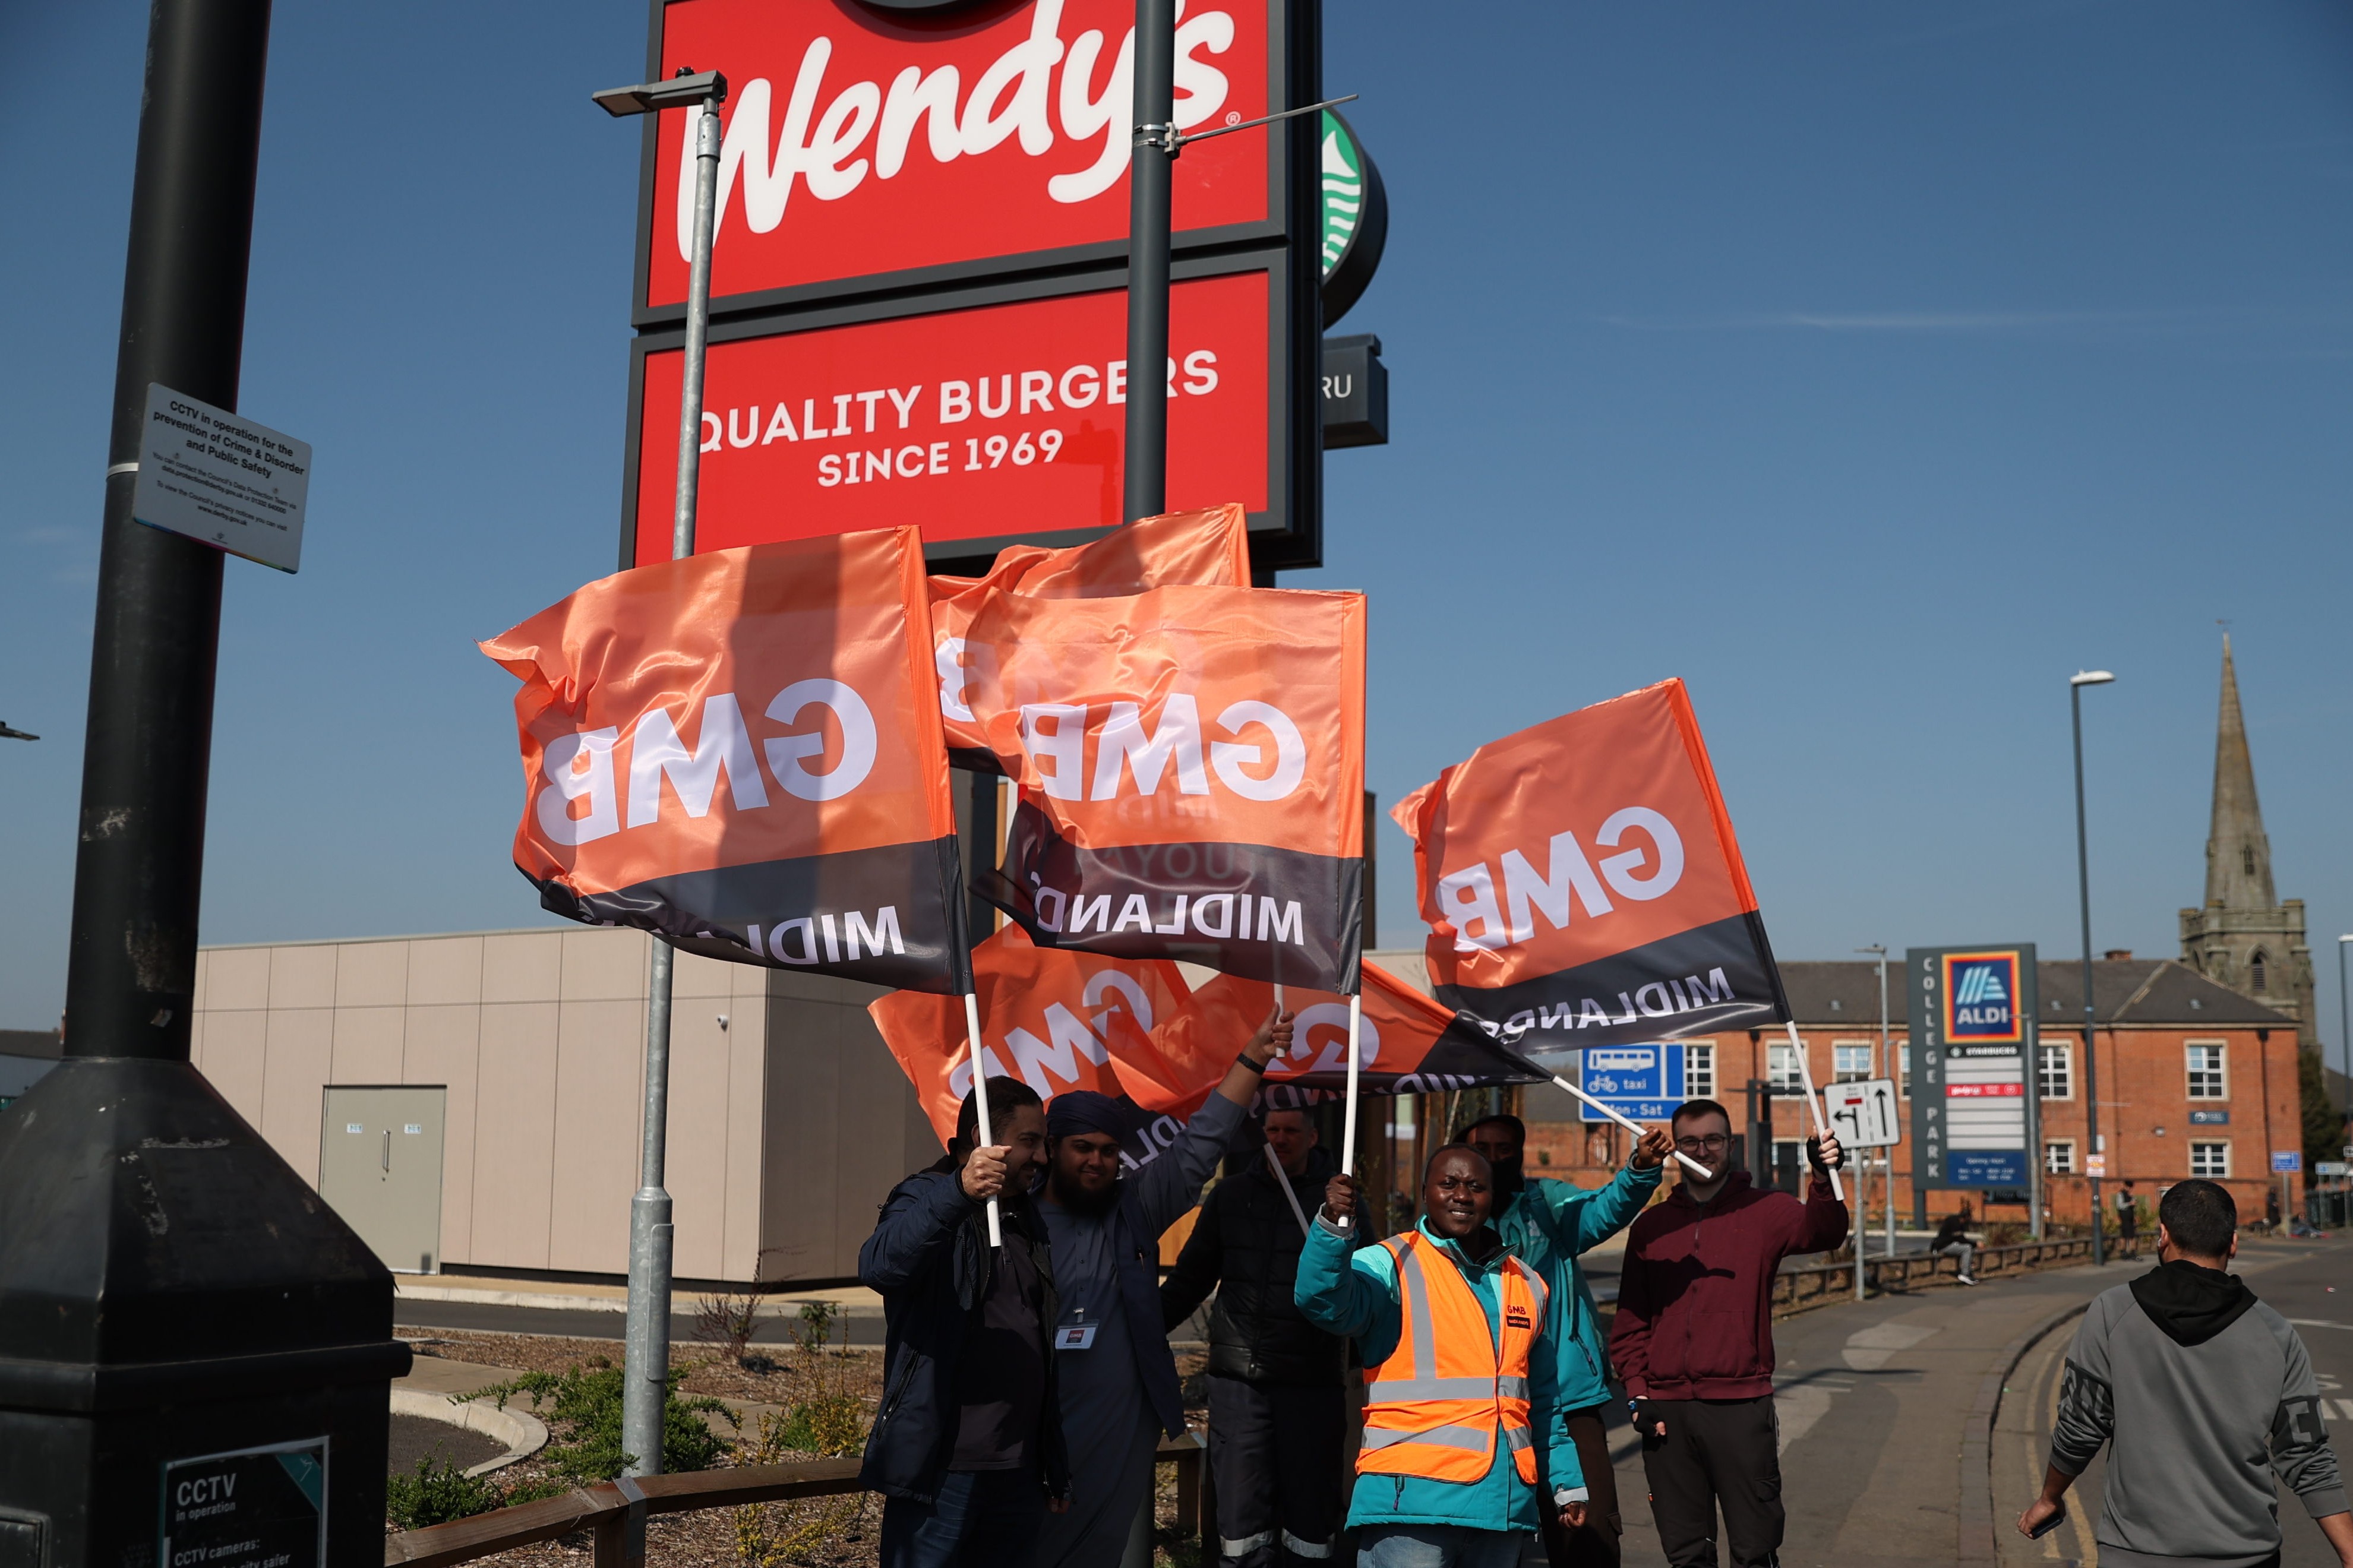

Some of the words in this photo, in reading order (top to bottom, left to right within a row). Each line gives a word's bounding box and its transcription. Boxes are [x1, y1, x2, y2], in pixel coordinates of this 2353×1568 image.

[677, 0, 1236, 263] Wendys
[1322, 374, 1352, 399] RU
[170, 400, 199, 419] CCTV
[201, 413, 210, 425] in
[213, 420, 259, 443] operation
[262, 437, 276, 450] for
[278, 443, 293, 457] the
[700, 385, 923, 453] QUALITY
[153, 411, 207, 438] prevention
[210, 434, 220, 444] of
[223, 437, 252, 455] Crime
[255, 450, 262, 459] &
[265, 453, 305, 475] Disorder
[186, 439, 205, 453] and
[208, 446, 239, 465] Public
[242, 459, 272, 479] Safety
[818, 441, 949, 486] SINCE
[965, 429, 1063, 472] 1969
[176, 461, 197, 473] contact
[198, 468, 207, 477] the
[233, 482, 246, 491] Data
[247, 486, 273, 501] Protection
[1923, 957, 1937, 1083] COLLEGE
[1957, 1007, 2007, 1025] ALDI
[1624, 1079, 1647, 1090] taxi
[1640, 1103, 1663, 1116] Sat
[1926, 1108, 1940, 1178] PARK
[1508, 1305, 1526, 1314] GMB
[176, 1472, 238, 1507] CCTV
[176, 1509, 185, 1522] in
[188, 1501, 236, 1520] operation
[175, 1546, 207, 1567] CCTV
[209, 1539, 261, 1560] cameras:
[263, 1553, 292, 1568] safer
